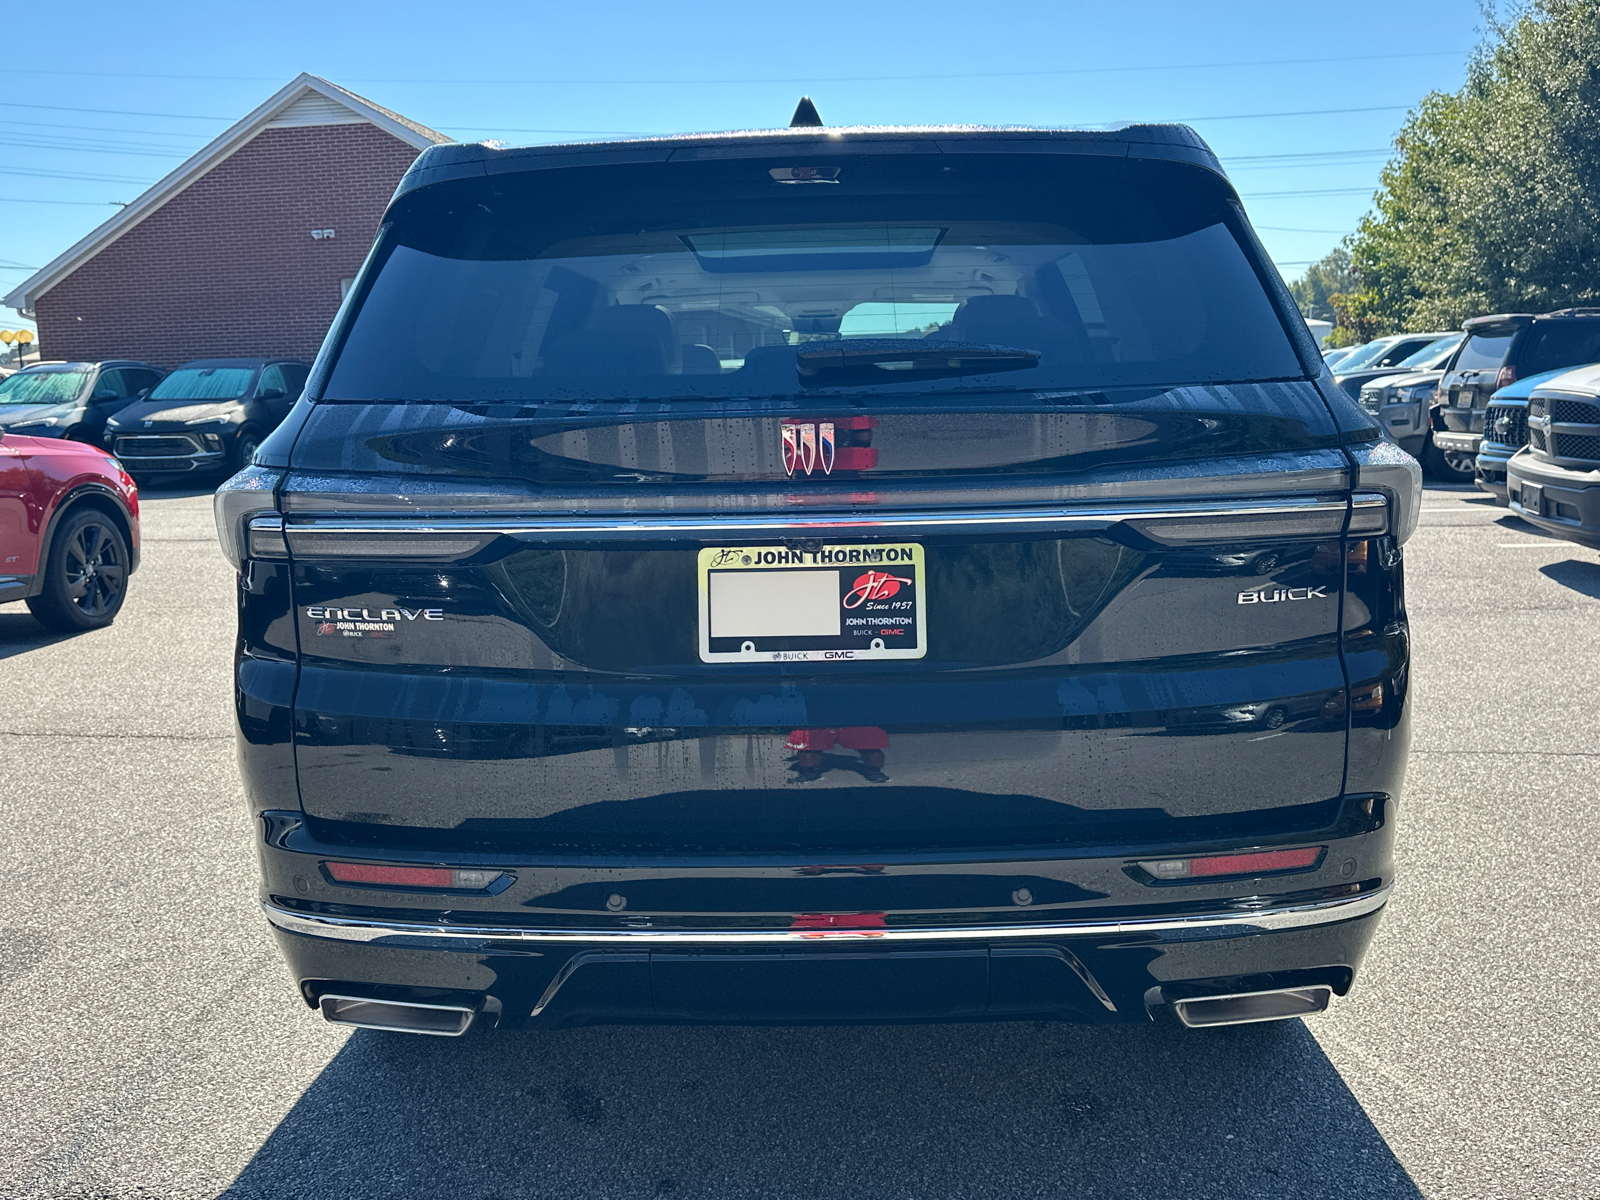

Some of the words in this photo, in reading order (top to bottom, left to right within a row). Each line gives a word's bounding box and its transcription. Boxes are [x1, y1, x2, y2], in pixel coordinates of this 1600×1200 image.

[754, 551, 804, 565] JOHN
[812, 548, 913, 563] THORNTON
[1238, 586, 1327, 604] BUICK
[866, 602, 889, 610] Since
[891, 601, 912, 609] 1957
[306, 606, 444, 621] ENCLAVE
[336, 621, 355, 630] JOHN
[355, 622, 394, 631] THORNTON
[845, 617, 866, 626] JOHN
[867, 617, 912, 625] THORNTON
[783, 652, 808, 660] BUICK
[824, 651, 854, 659] GMC
